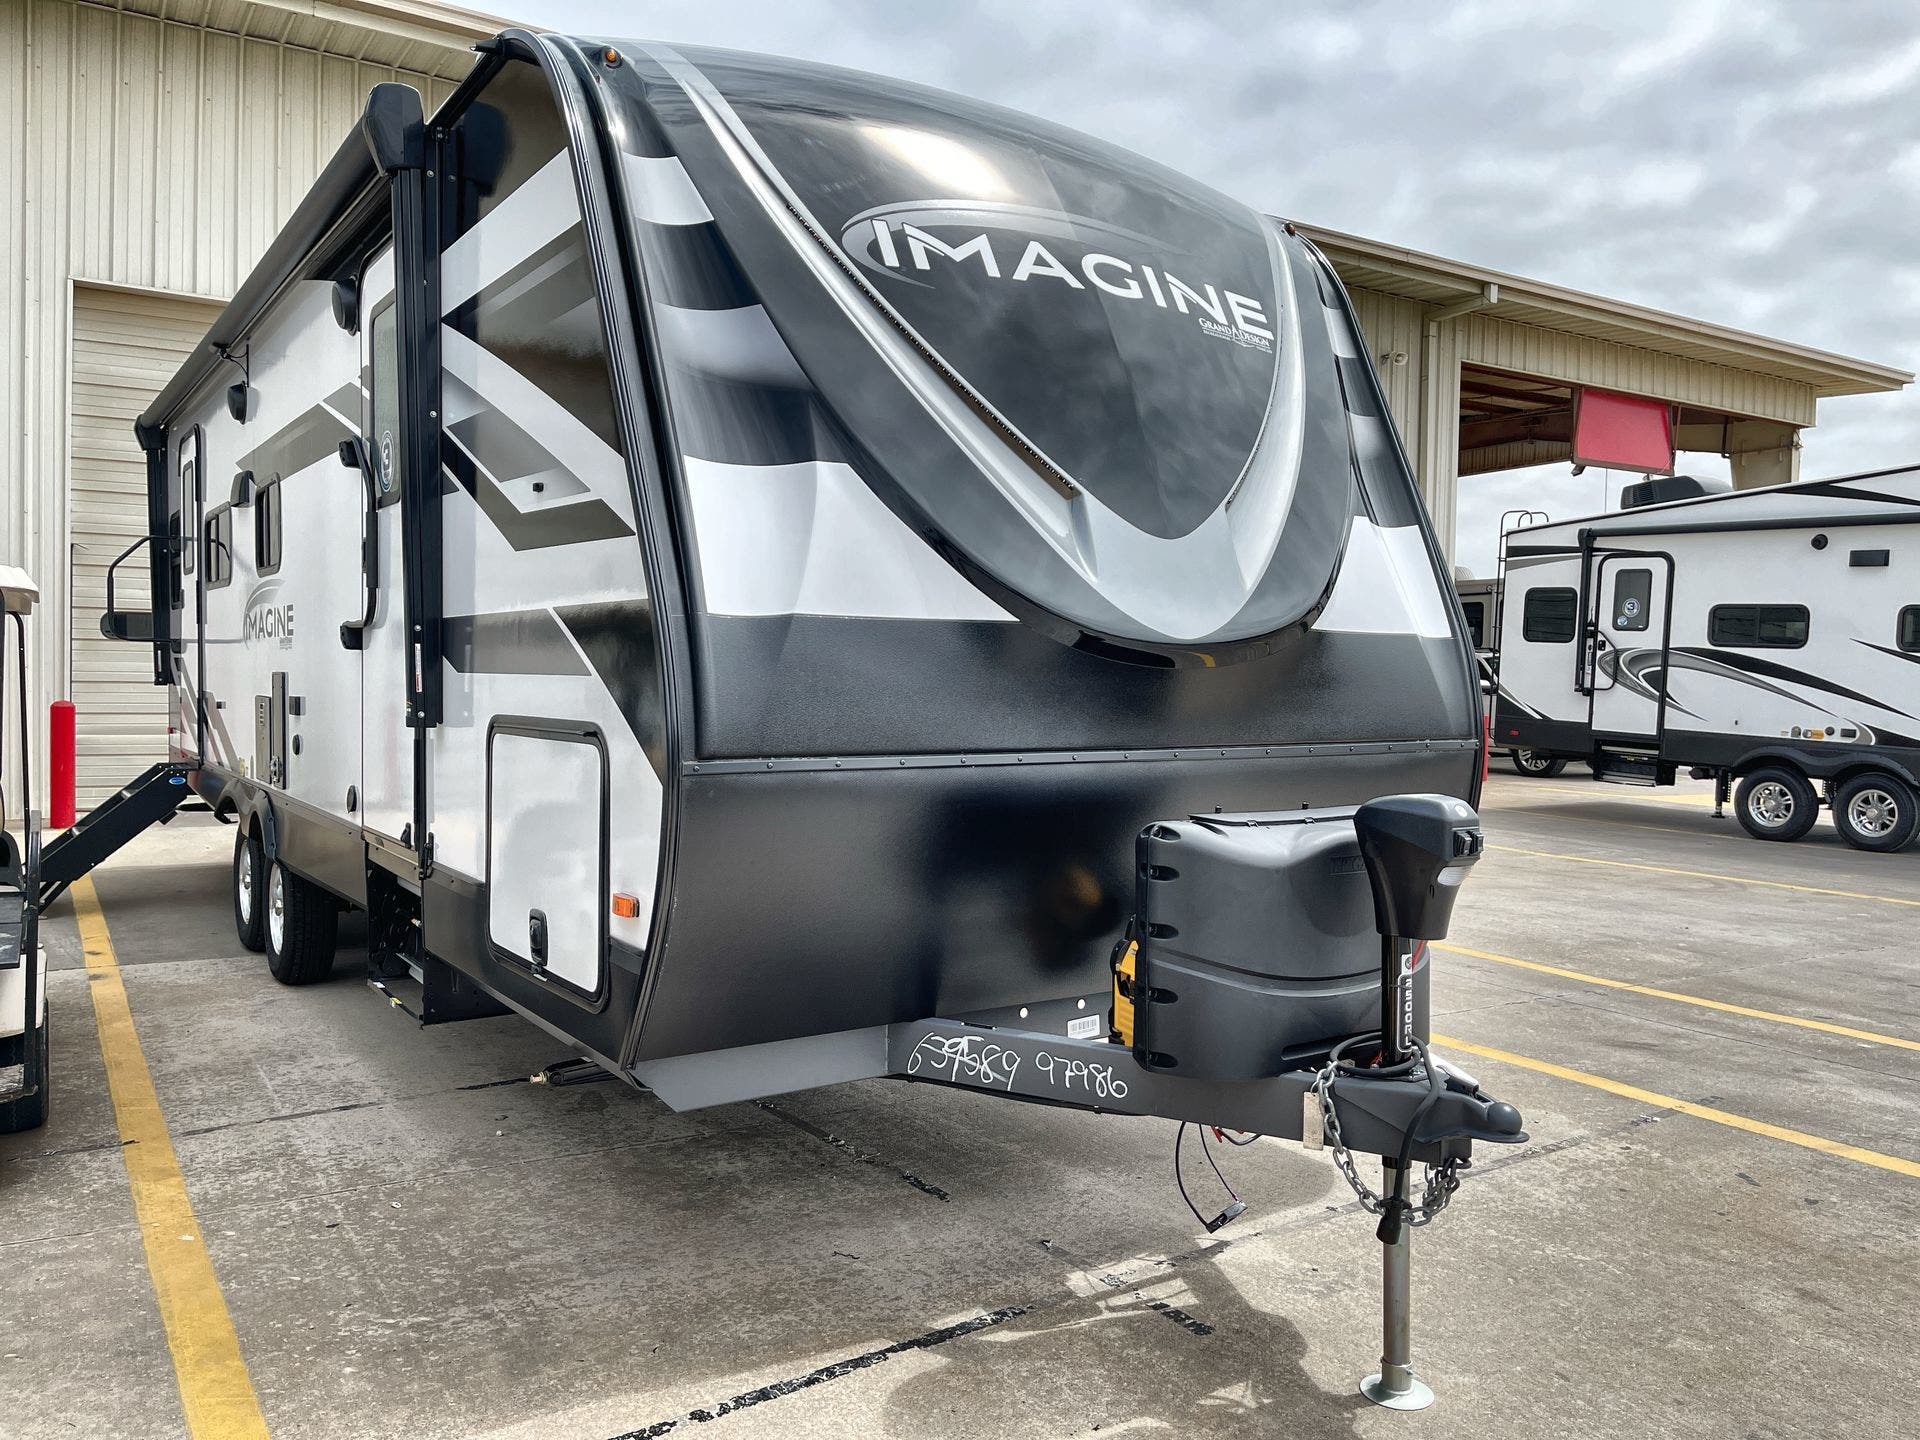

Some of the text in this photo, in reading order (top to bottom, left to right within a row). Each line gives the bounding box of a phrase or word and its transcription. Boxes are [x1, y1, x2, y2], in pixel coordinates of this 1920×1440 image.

[870, 218, 1274, 340] IMAGINE
[1198, 317, 1232, 335] GRAND
[1240, 330, 1270, 347] DESIGN
[245, 604, 294, 641] IMAGINE
[1035, 1051, 1127, 1098] 97986
